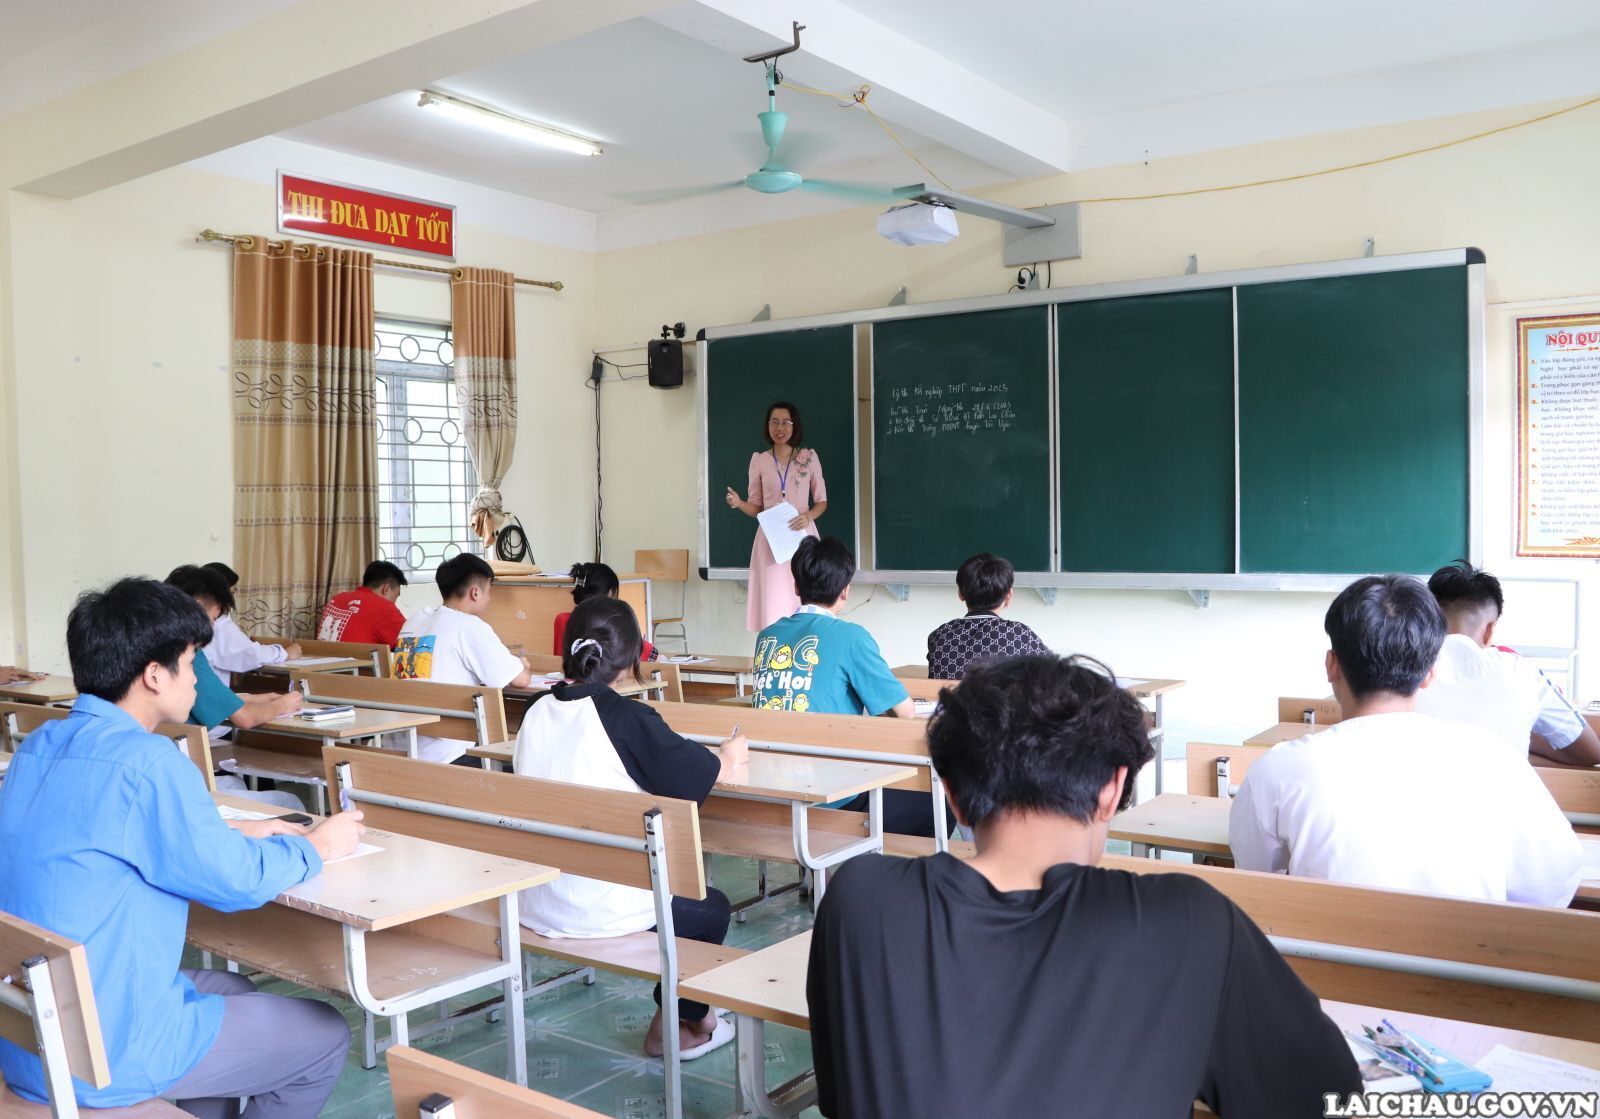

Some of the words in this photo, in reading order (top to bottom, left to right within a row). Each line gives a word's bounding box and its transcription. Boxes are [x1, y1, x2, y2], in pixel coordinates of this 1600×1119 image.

[287, 189, 325, 220] THI
[330, 199, 369, 231] ĐUA
[374, 207, 411, 244] DẠY
[415, 211, 449, 244] TỐT
[1545, 330, 1573, 347] NỘI
[948, 383, 967, 395] THPT
